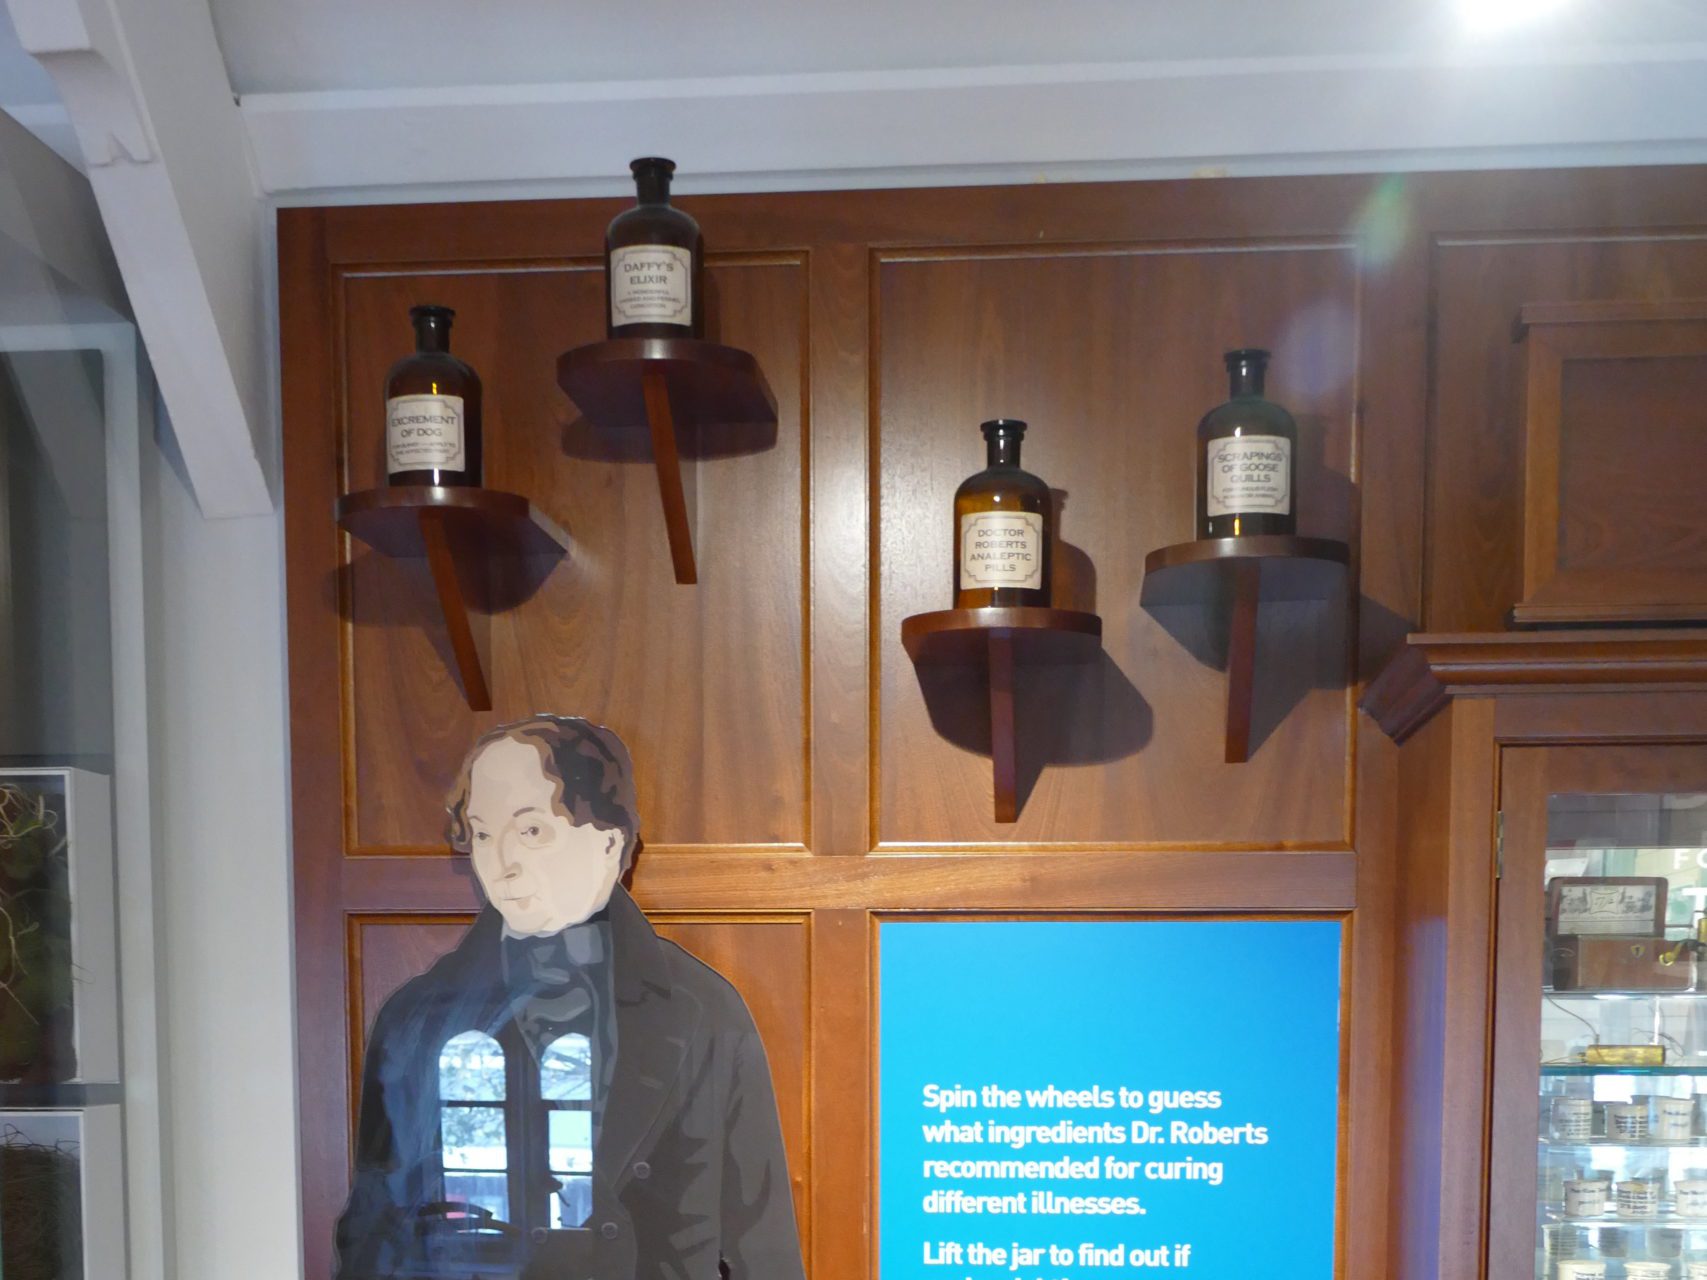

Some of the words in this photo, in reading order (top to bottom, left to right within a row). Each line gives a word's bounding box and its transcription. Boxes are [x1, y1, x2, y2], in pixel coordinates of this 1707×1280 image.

[630, 276, 667, 284] ELIXIR
[391, 415, 456, 427] EXCREMENT
[401, 429, 414, 437] OF
[1217, 452, 1283, 463] SCRAPINGS
[1222, 464, 1236, 473] OF
[1239, 463, 1279, 472] GOOSE
[1230, 474, 1272, 483] QUILLS
[977, 528, 1025, 538] DOCTOR
[975, 541, 1027, 549] ROBERTS
[970, 552, 1032, 561] ANALEPTIC
[984, 563, 1017, 572] PILLS
[923, 1084, 977, 1113] Spin
[981, 1084, 1022, 1108] the
[1025, 1084, 1115, 1108] wheels
[1119, 1086, 1144, 1108] to
[1148, 1090, 1222, 1114] guess
[922, 1120, 984, 1143] what
[988, 1120, 1126, 1149] ingredients
[1132, 1121, 1165, 1144] Dr.
[1170, 1121, 1268, 1145] Roberts
[923, 1156, 1100, 1179] recommended
[1104, 1156, 1141, 1179] for
[1145, 1157, 1223, 1185] curing
[922, 1190, 1027, 1214] different
[1031, 1191, 1147, 1215] illnesses.
[923, 1241, 963, 1265] Lift
[967, 1242, 1007, 1265] the
[1009, 1242, 1046, 1271] jar
[1049, 1244, 1074, 1266] to
[1078, 1243, 1124, 1267] find
[1129, 1246, 1169, 1267] out
[1174, 1244, 1191, 1267] if
